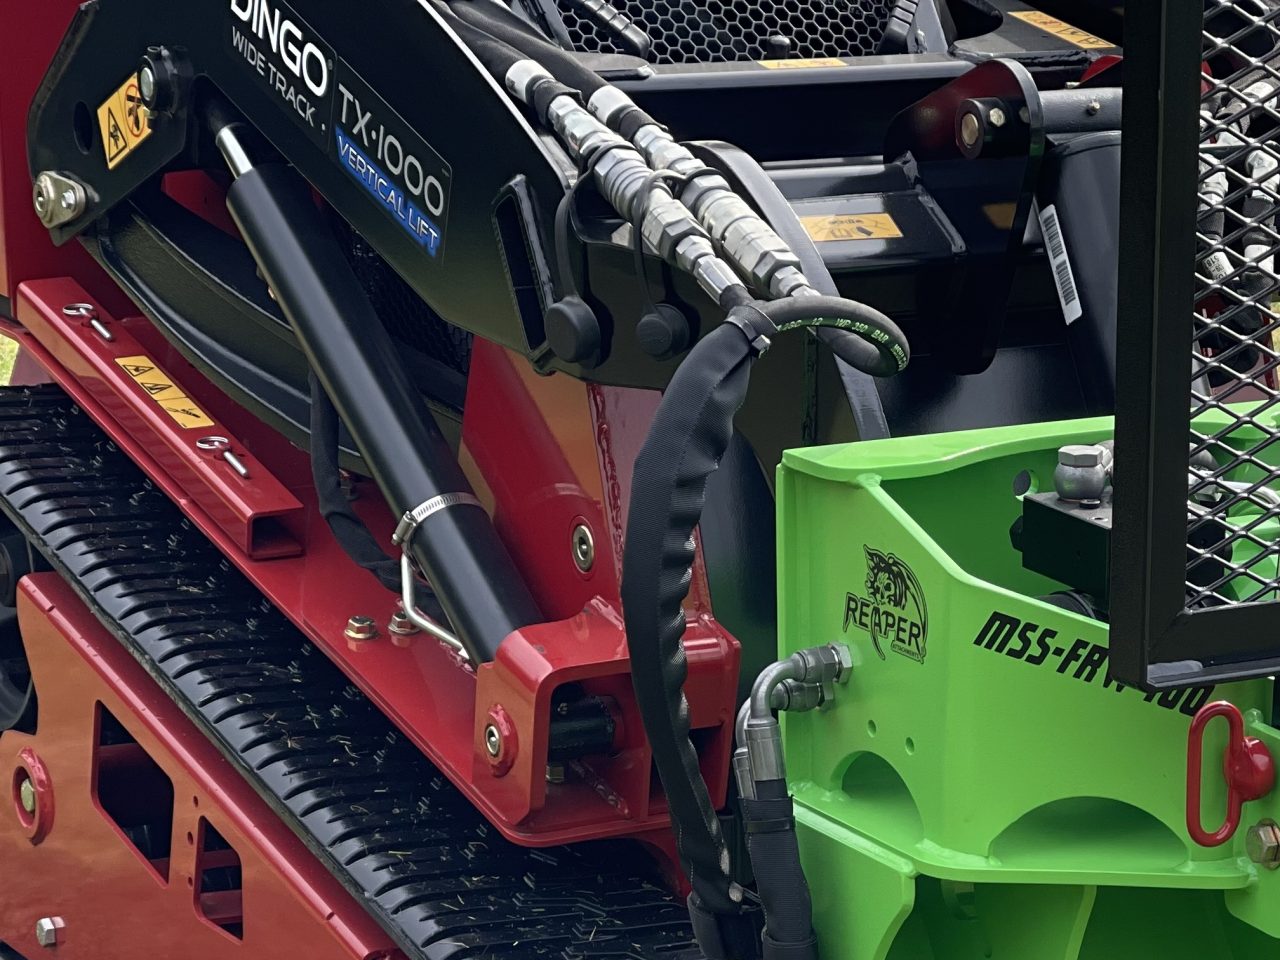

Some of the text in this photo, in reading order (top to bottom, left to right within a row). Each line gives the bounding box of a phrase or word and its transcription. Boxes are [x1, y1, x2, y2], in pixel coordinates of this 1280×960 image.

[232, 26, 316, 127] WIDE TRACK
[338, 135, 438, 249] VERTICAL LIFT
[871, 329, 889, 344] BAR
[844, 594, 922, 657] REAPER
